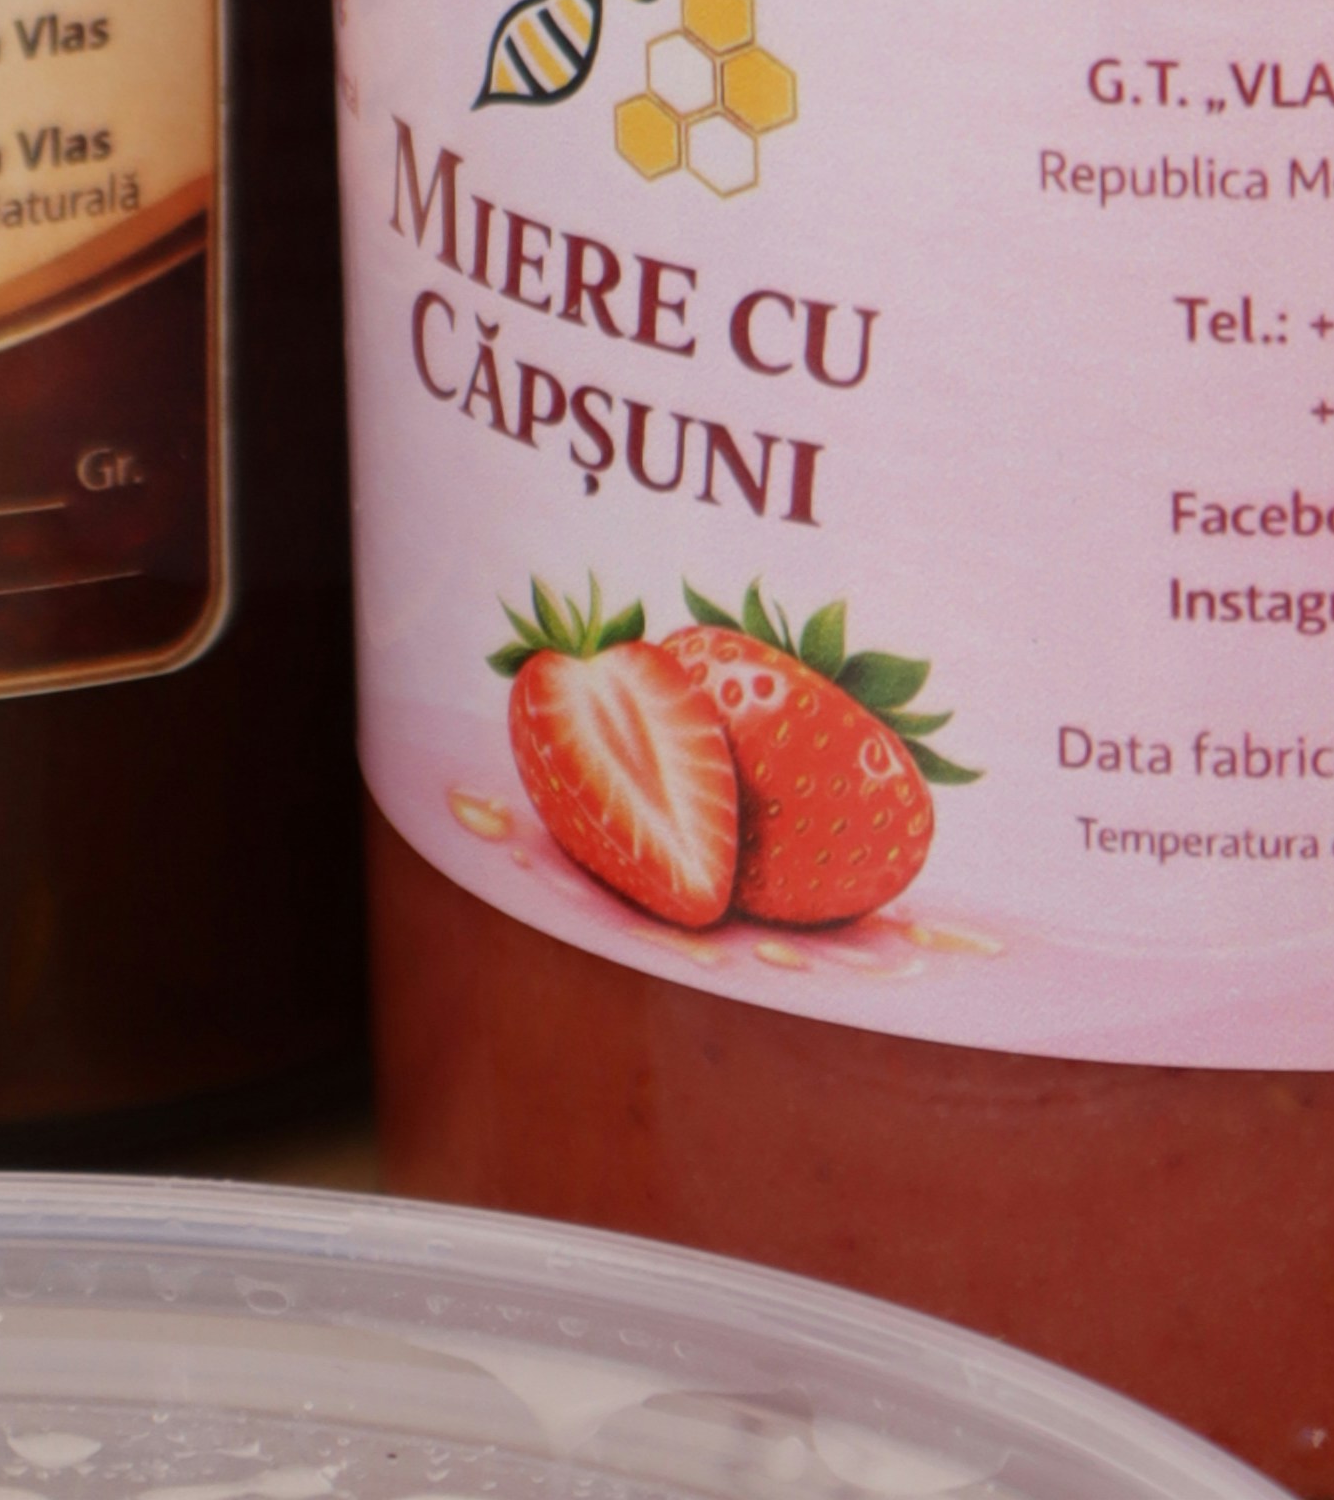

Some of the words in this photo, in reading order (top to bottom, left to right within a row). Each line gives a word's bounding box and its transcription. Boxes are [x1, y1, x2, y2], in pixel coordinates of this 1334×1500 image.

[14, 13, 110, 60] Vlas
[1087, 58, 1190, 107] G.T.
[17, 125, 113, 172] Vlas
[1039, 150, 1268, 207] Republica
[389, 113, 698, 358] MIERE
[729, 288, 882, 390] CU
[1174, 295, 1289, 344] Tel.:
[410, 289, 827, 528] CĂPȘUNI
[76, 446, 144, 492] Gr.
[1057, 725, 1173, 775] Data
[1076, 815, 1319, 865] Temperatura
